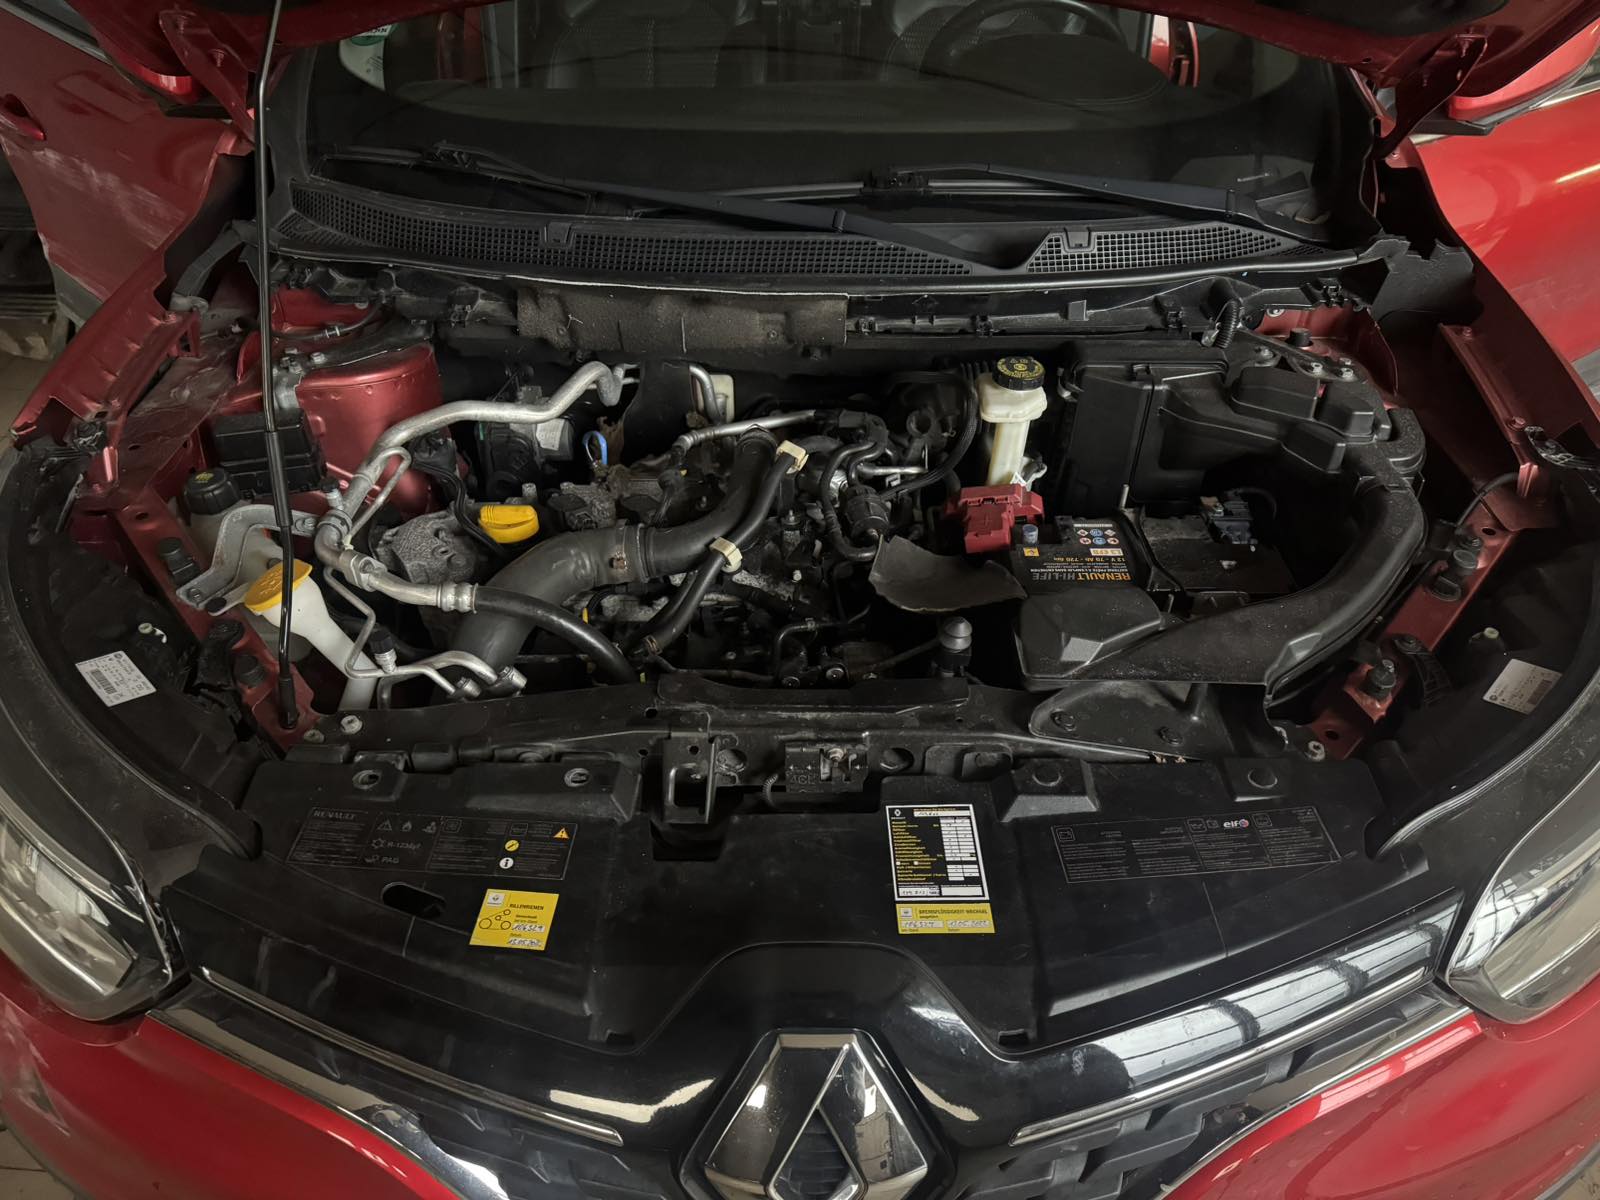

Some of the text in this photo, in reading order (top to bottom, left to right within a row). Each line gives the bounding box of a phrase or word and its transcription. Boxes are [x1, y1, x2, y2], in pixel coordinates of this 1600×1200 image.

[1032, 572, 1131, 581] RENAULT HI-LIFE
[1223, 818, 1240, 829] elf
